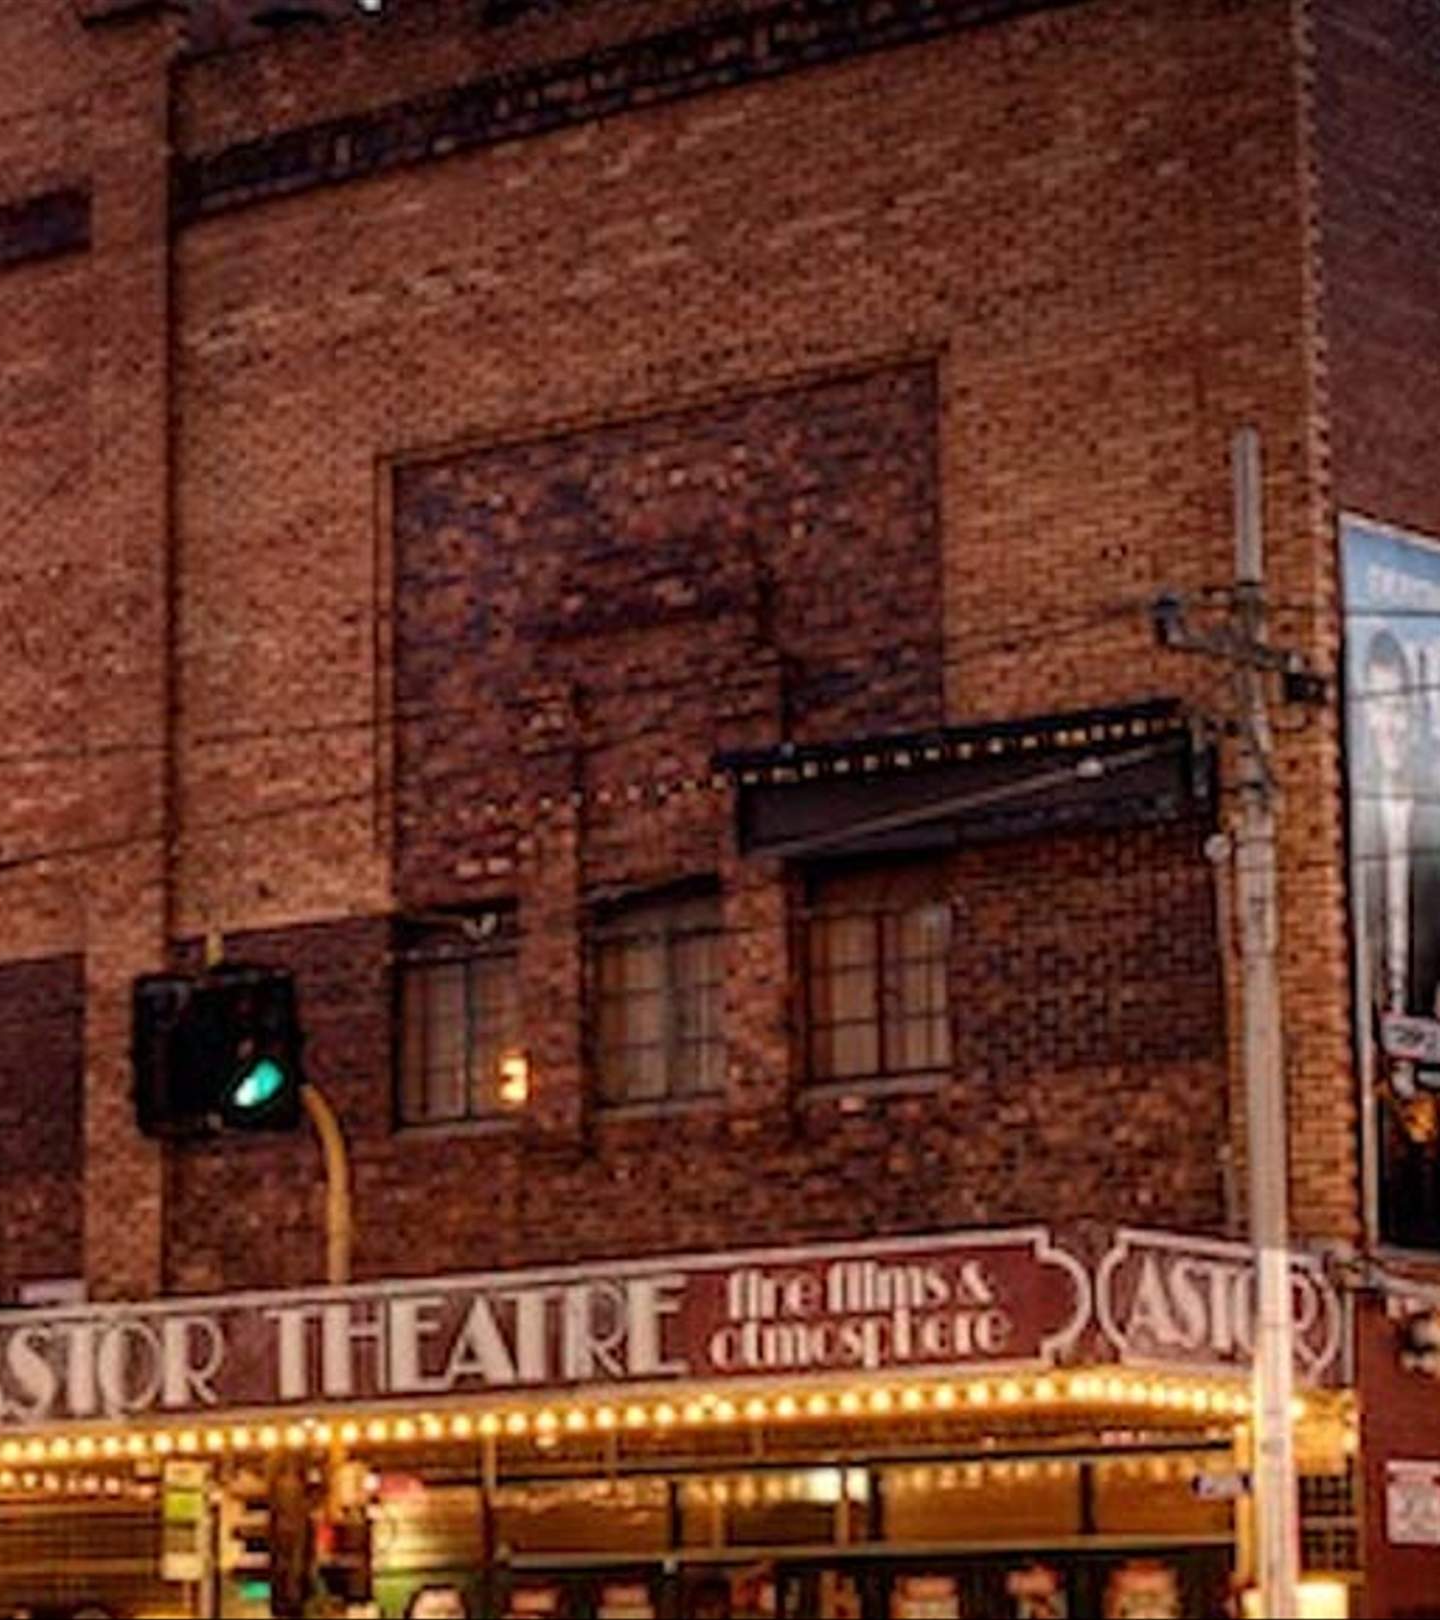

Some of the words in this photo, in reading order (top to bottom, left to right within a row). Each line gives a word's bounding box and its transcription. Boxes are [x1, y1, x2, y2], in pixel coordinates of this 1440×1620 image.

[827, 1261, 949, 1313] films
[959, 1259, 995, 1303] &
[263, 1274, 688, 1400] THEATRE
[710, 1308, 1011, 1370] atmosphere
